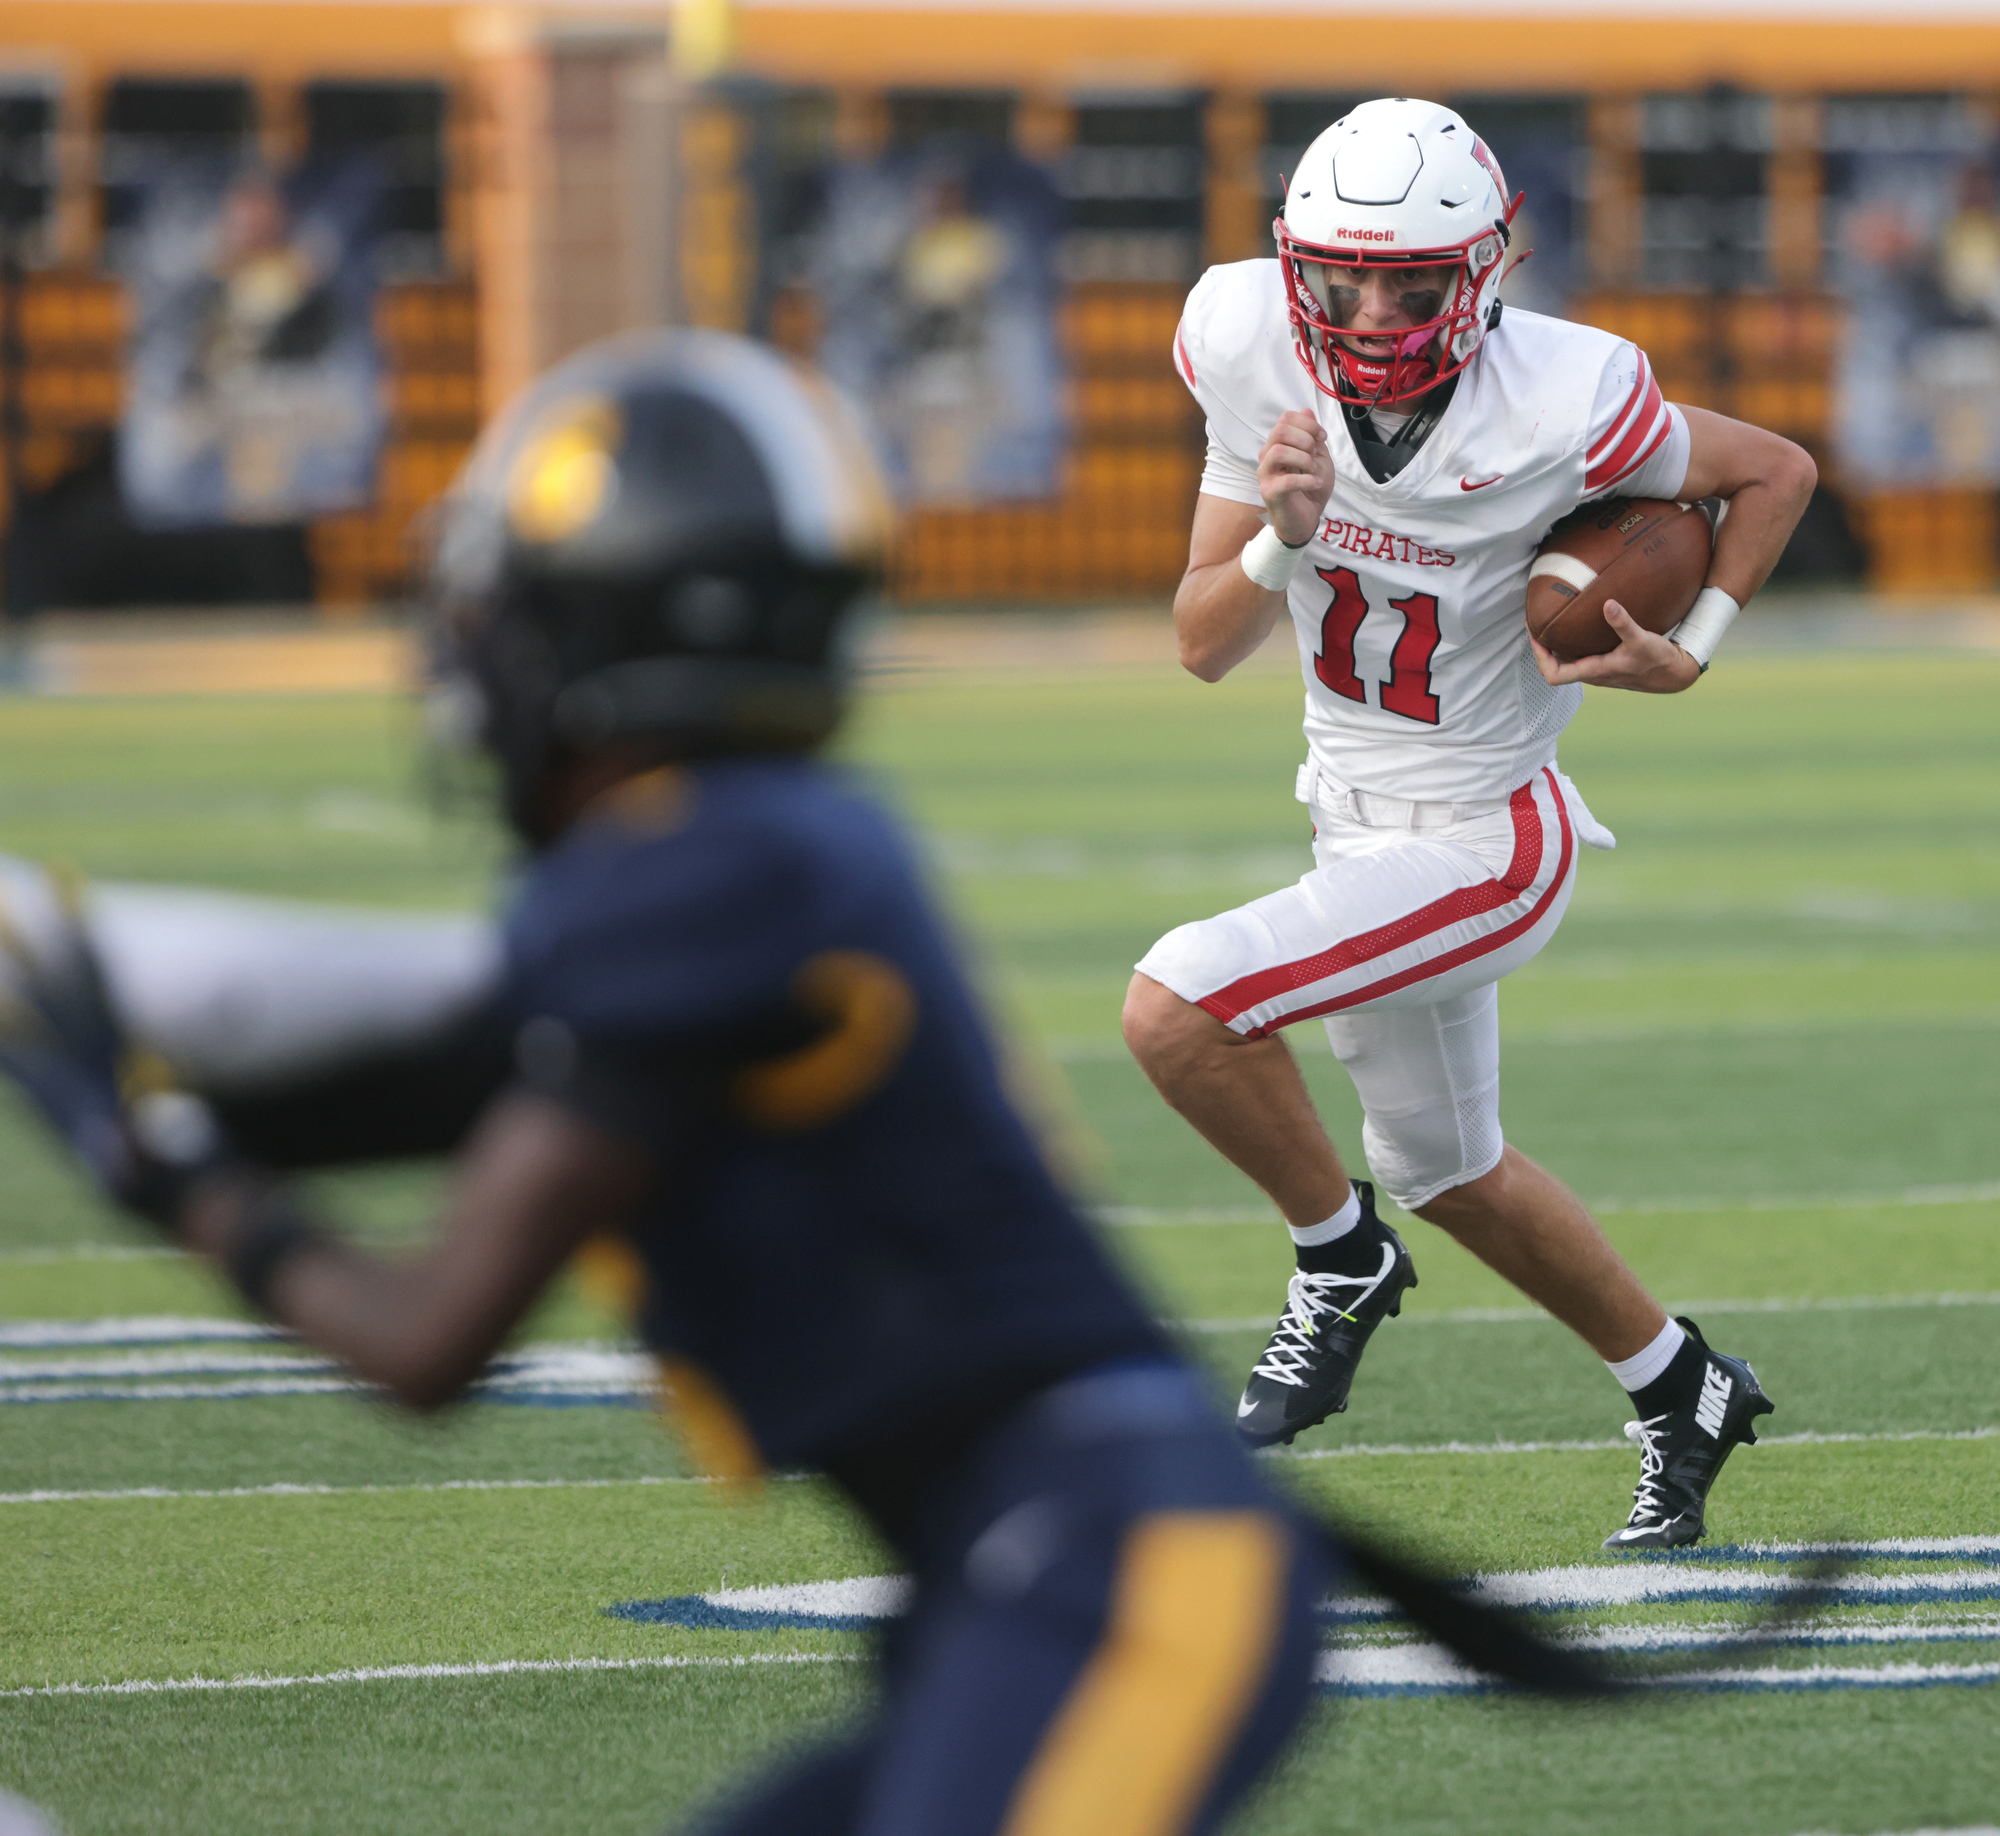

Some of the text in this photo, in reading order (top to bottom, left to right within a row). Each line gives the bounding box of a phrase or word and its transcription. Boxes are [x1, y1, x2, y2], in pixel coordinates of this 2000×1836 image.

[1337, 228, 1394, 242] Riddell
[1357, 364, 1387, 376] Riddell
[1618, 513, 1645, 534] NCAA
[1320, 517, 1456, 567] PIRATES
[1314, 564, 1442, 726] 11
[1695, 1361, 1733, 1440] NIKE
